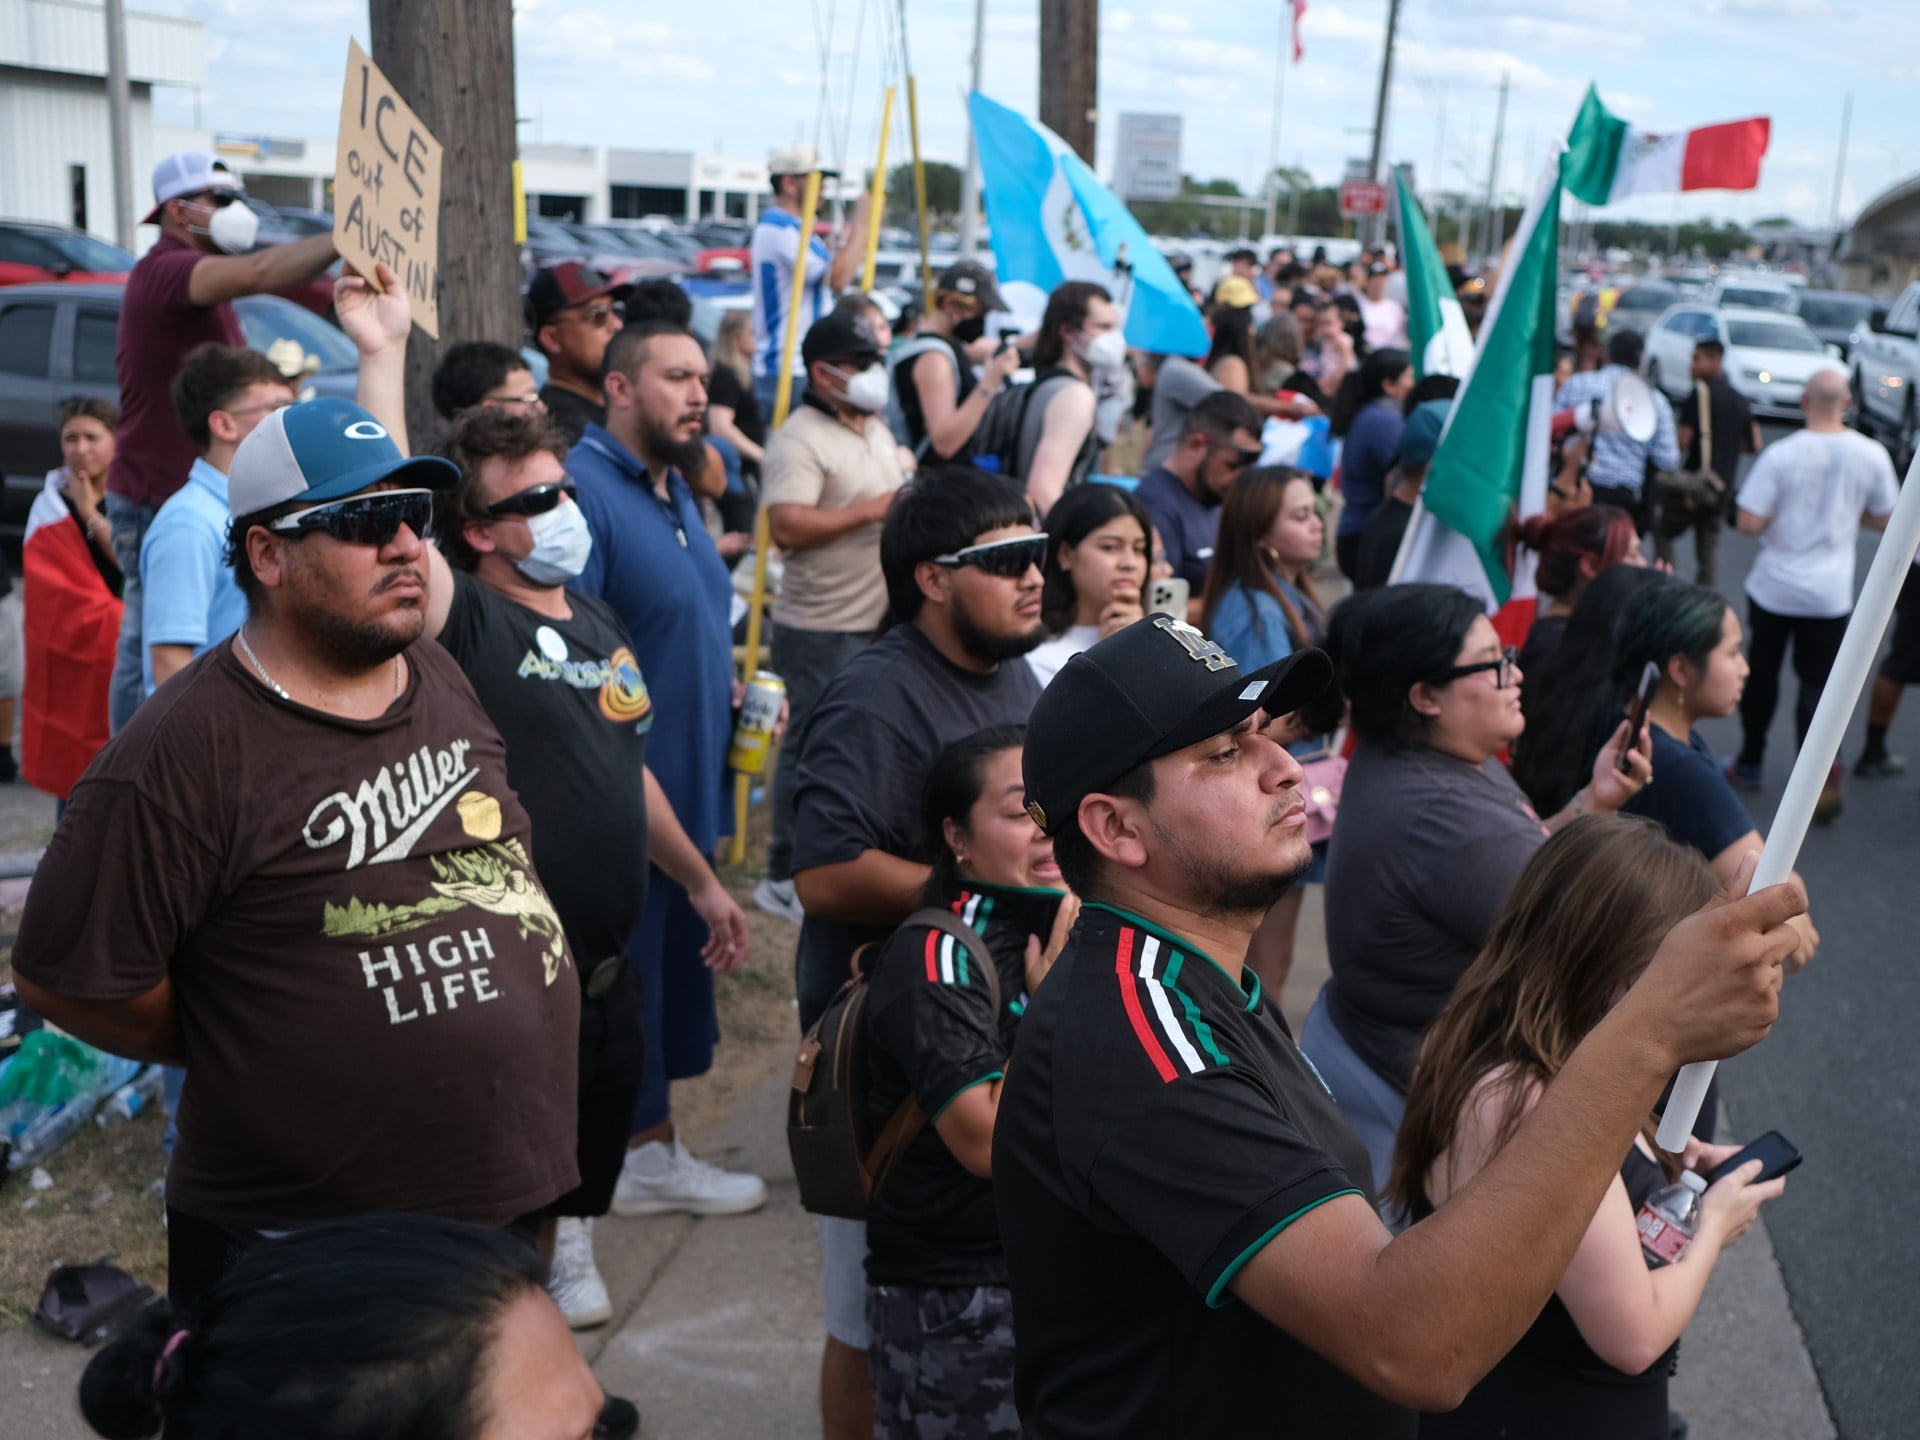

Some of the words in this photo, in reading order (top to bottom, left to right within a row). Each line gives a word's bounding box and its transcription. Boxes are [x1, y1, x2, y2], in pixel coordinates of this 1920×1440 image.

[360, 65, 428, 198] ICE
[347, 150, 383, 205] out
[400, 207, 423, 243] of
[302, 738, 471, 870] Miller
[358, 927, 496, 988] HIGH
[382, 967, 499, 1024] LIFE
